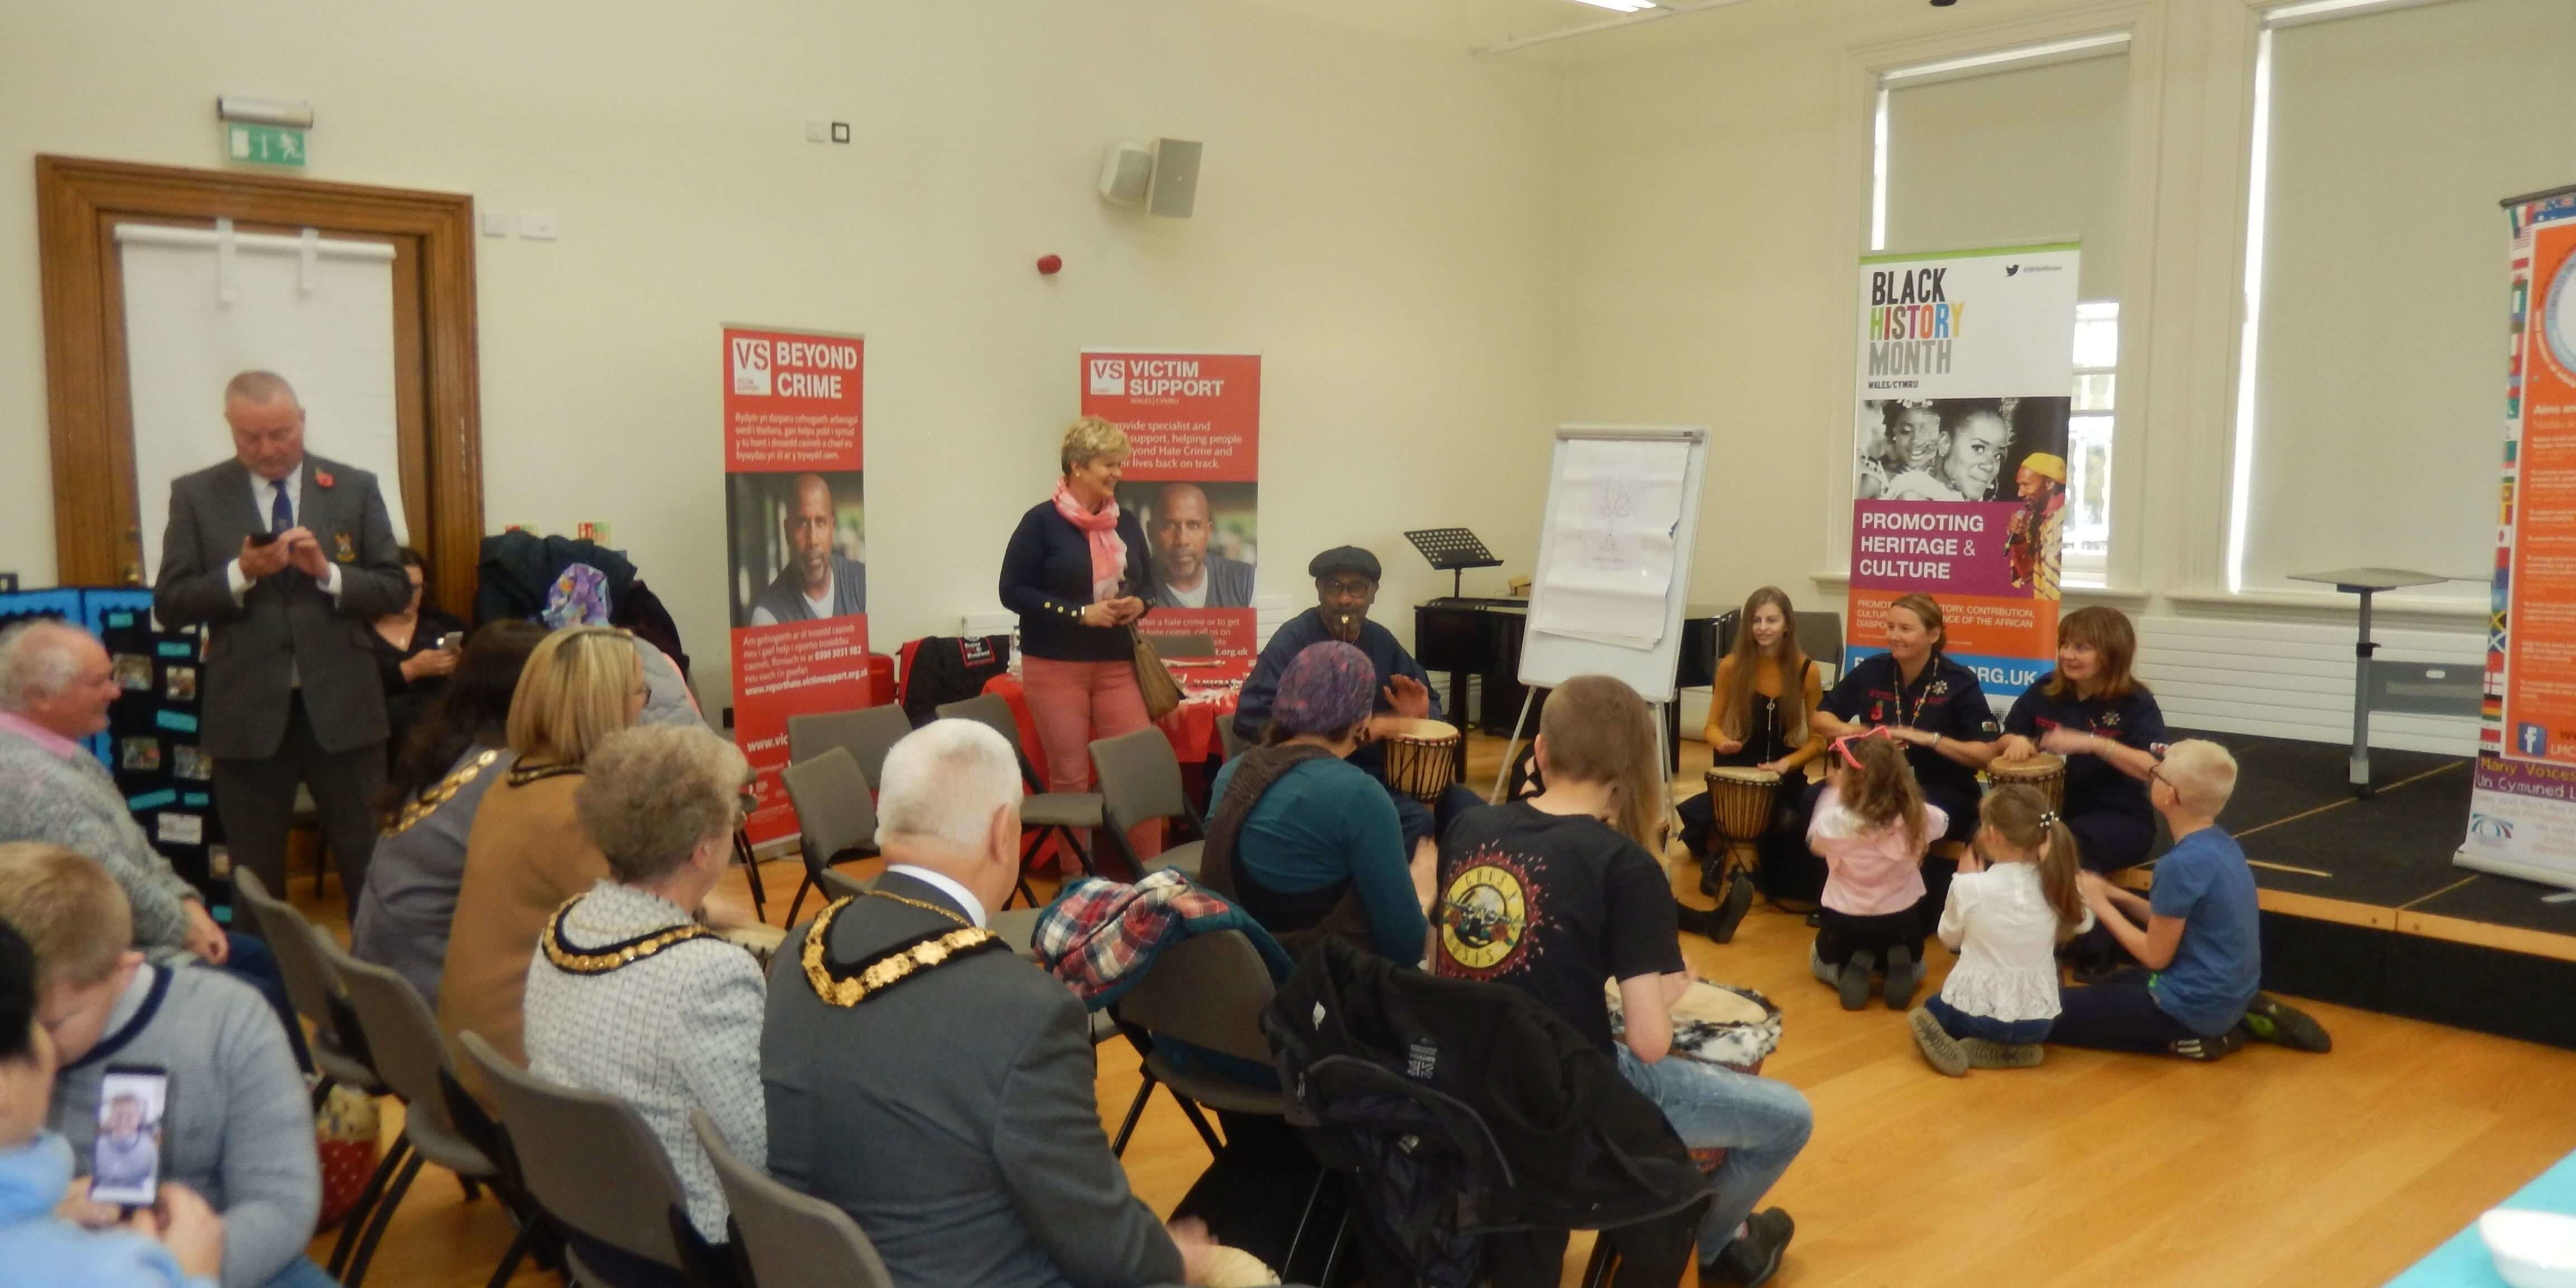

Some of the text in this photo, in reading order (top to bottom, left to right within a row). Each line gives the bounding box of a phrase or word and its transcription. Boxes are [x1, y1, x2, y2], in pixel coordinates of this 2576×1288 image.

[1872, 267, 1947, 306] BLACK
[1869, 301, 1964, 340] HISTORY
[736, 342, 769, 371] VS
[776, 342, 857, 370] BEYOND
[1868, 339, 1952, 376] MONTH
[1094, 362, 1123, 380] VS
[1130, 360, 1199, 377] VICTIM
[778, 372, 842, 399] CRIME
[1130, 380, 1224, 396] SUPPORT
[1868, 380, 1919, 389] WALES/CYMRU
[1148, 420, 1190, 432] specialist
[1192, 422, 1210, 431] and
[1172, 434, 1208, 446] helping
[1210, 434, 1242, 446] people
[1131, 447, 1232, 458] yond Hate Crime and
[1133, 460, 1153, 468] lives
[1156, 459, 1178, 468] back
[1195, 460, 1220, 468] track.
[1862, 513, 1984, 532] PROMOTING
[1861, 537, 1976, 556] HERITAGE &
[1859, 559, 1950, 579] CULTURE
[1857, 599, 1892, 609] PROMOT
[1227, 618, 1239, 628] get
[1857, 609, 1887, 618] CULTUR
[1976, 617, 1992, 626] THE
[1994, 618, 2033, 628] AFRICAN
[1857, 619, 1887, 629] DIASPO
[1215, 647, 1248, 658] t.org.uk
[1968, 666, 2037, 686] RG.UK
[747, 733, 788, 752] www.vic
[2498, 776, 2564, 798] Cymuned
